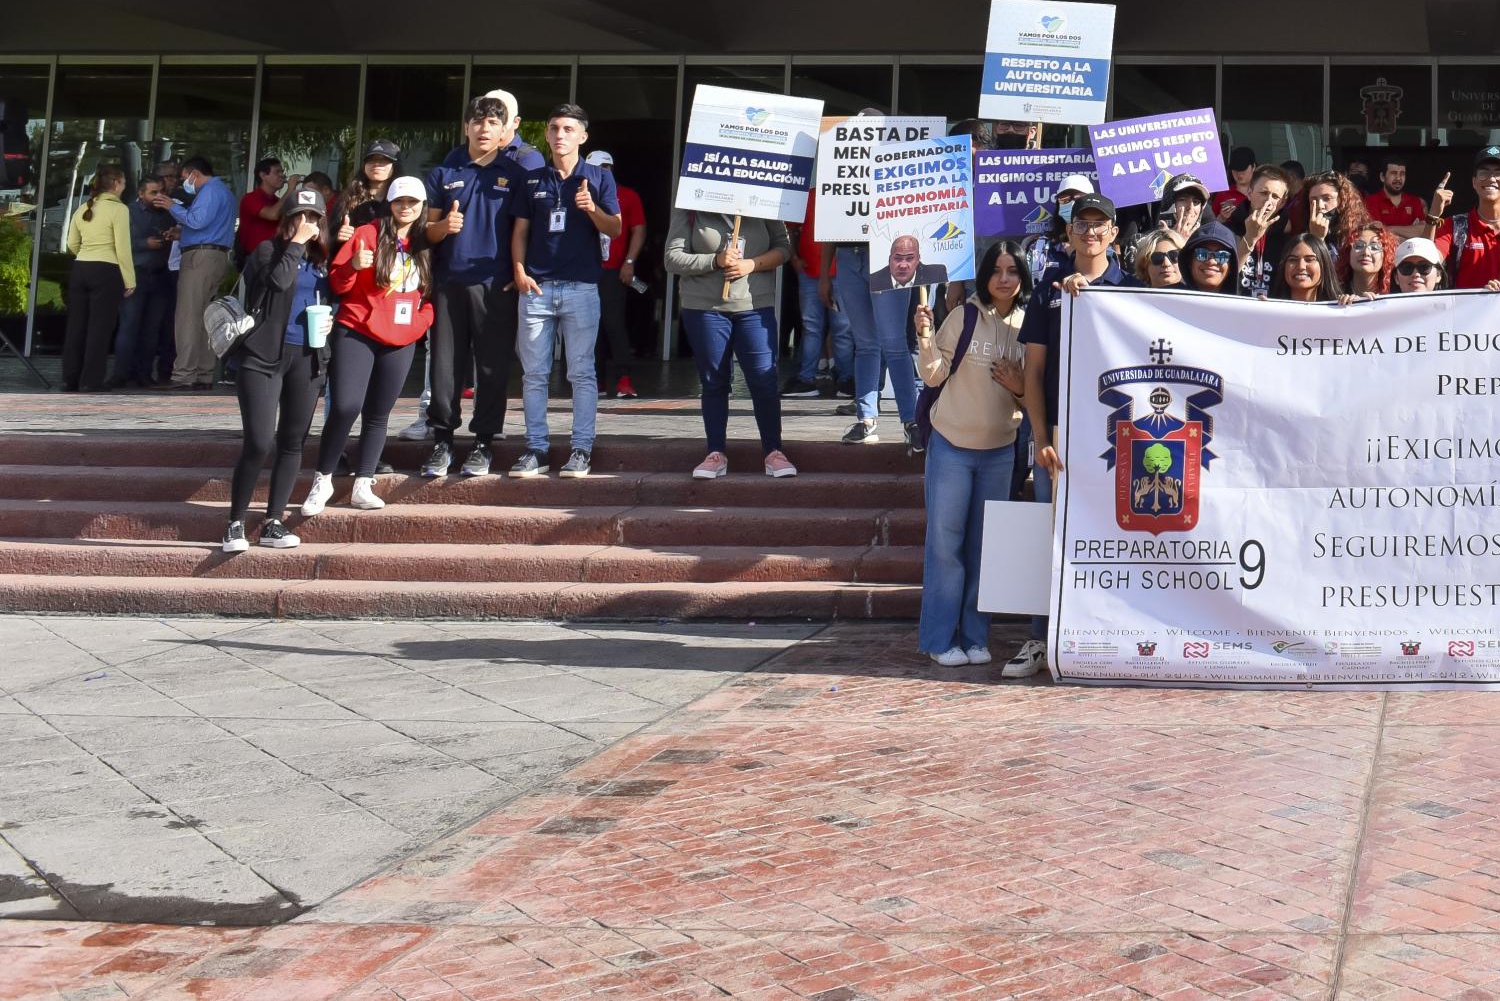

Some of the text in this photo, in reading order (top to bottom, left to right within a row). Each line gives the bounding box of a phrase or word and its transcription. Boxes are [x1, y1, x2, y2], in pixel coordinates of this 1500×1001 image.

[1001, 57, 1092, 72] RESPETO A LA
[1005, 69, 1085, 85] AUTONOMÍA
[994, 81, 1094, 97] UNIVERSITARIA
[719, 123, 745, 131] VAMOS
[745, 126, 759, 134] POR
[835, 126, 930, 142] BASTA DE
[1093, 114, 1212, 141] LAS UNIVERSITARIAS
[874, 143, 968, 164] GOBERNADOR:
[1096, 130, 1215, 158] EXIGIMOS RESPETO
[704, 152, 793, 172] ¡SÍ A LA SALUD!
[873, 156, 967, 181] EXIGIMOS
[979, 156, 1001, 166] LAS
[1112, 145, 1208, 177] A LA UdeG
[687, 162, 806, 186] ¡SÍ A LA EDUCACIÓN!
[876, 173, 969, 194] RESPETO A LA
[978, 171, 1044, 184] EXIGIMOS
[875, 185, 967, 209] AUTONOMÍA
[988, 191, 1003, 205] A
[1006, 190, 1029, 205] LA
[876, 200, 969, 220] UNIVERSITARIA
[1275, 333, 1386, 357] SISTEMA
[1394, 334, 1427, 354] DE
[1102, 368, 1220, 388] UNIVERSIDAD DE GUADALAJARA
[1074, 538, 1233, 560] PREPARATORIA
[1238, 539, 1266, 591] 9
[1073, 569, 1234, 592] HIGH SCHOOL
[1063, 628, 1146, 637] BIENVENIDOS
[1166, 628, 1231, 637] WELCOME
[1247, 628, 1319, 637] BIENVENUE
[1324, 628, 1409, 637] BIENVENIDOS
[1428, 627, 1495, 636] WELCOME
[1213, 641, 1254, 650] SEMS
